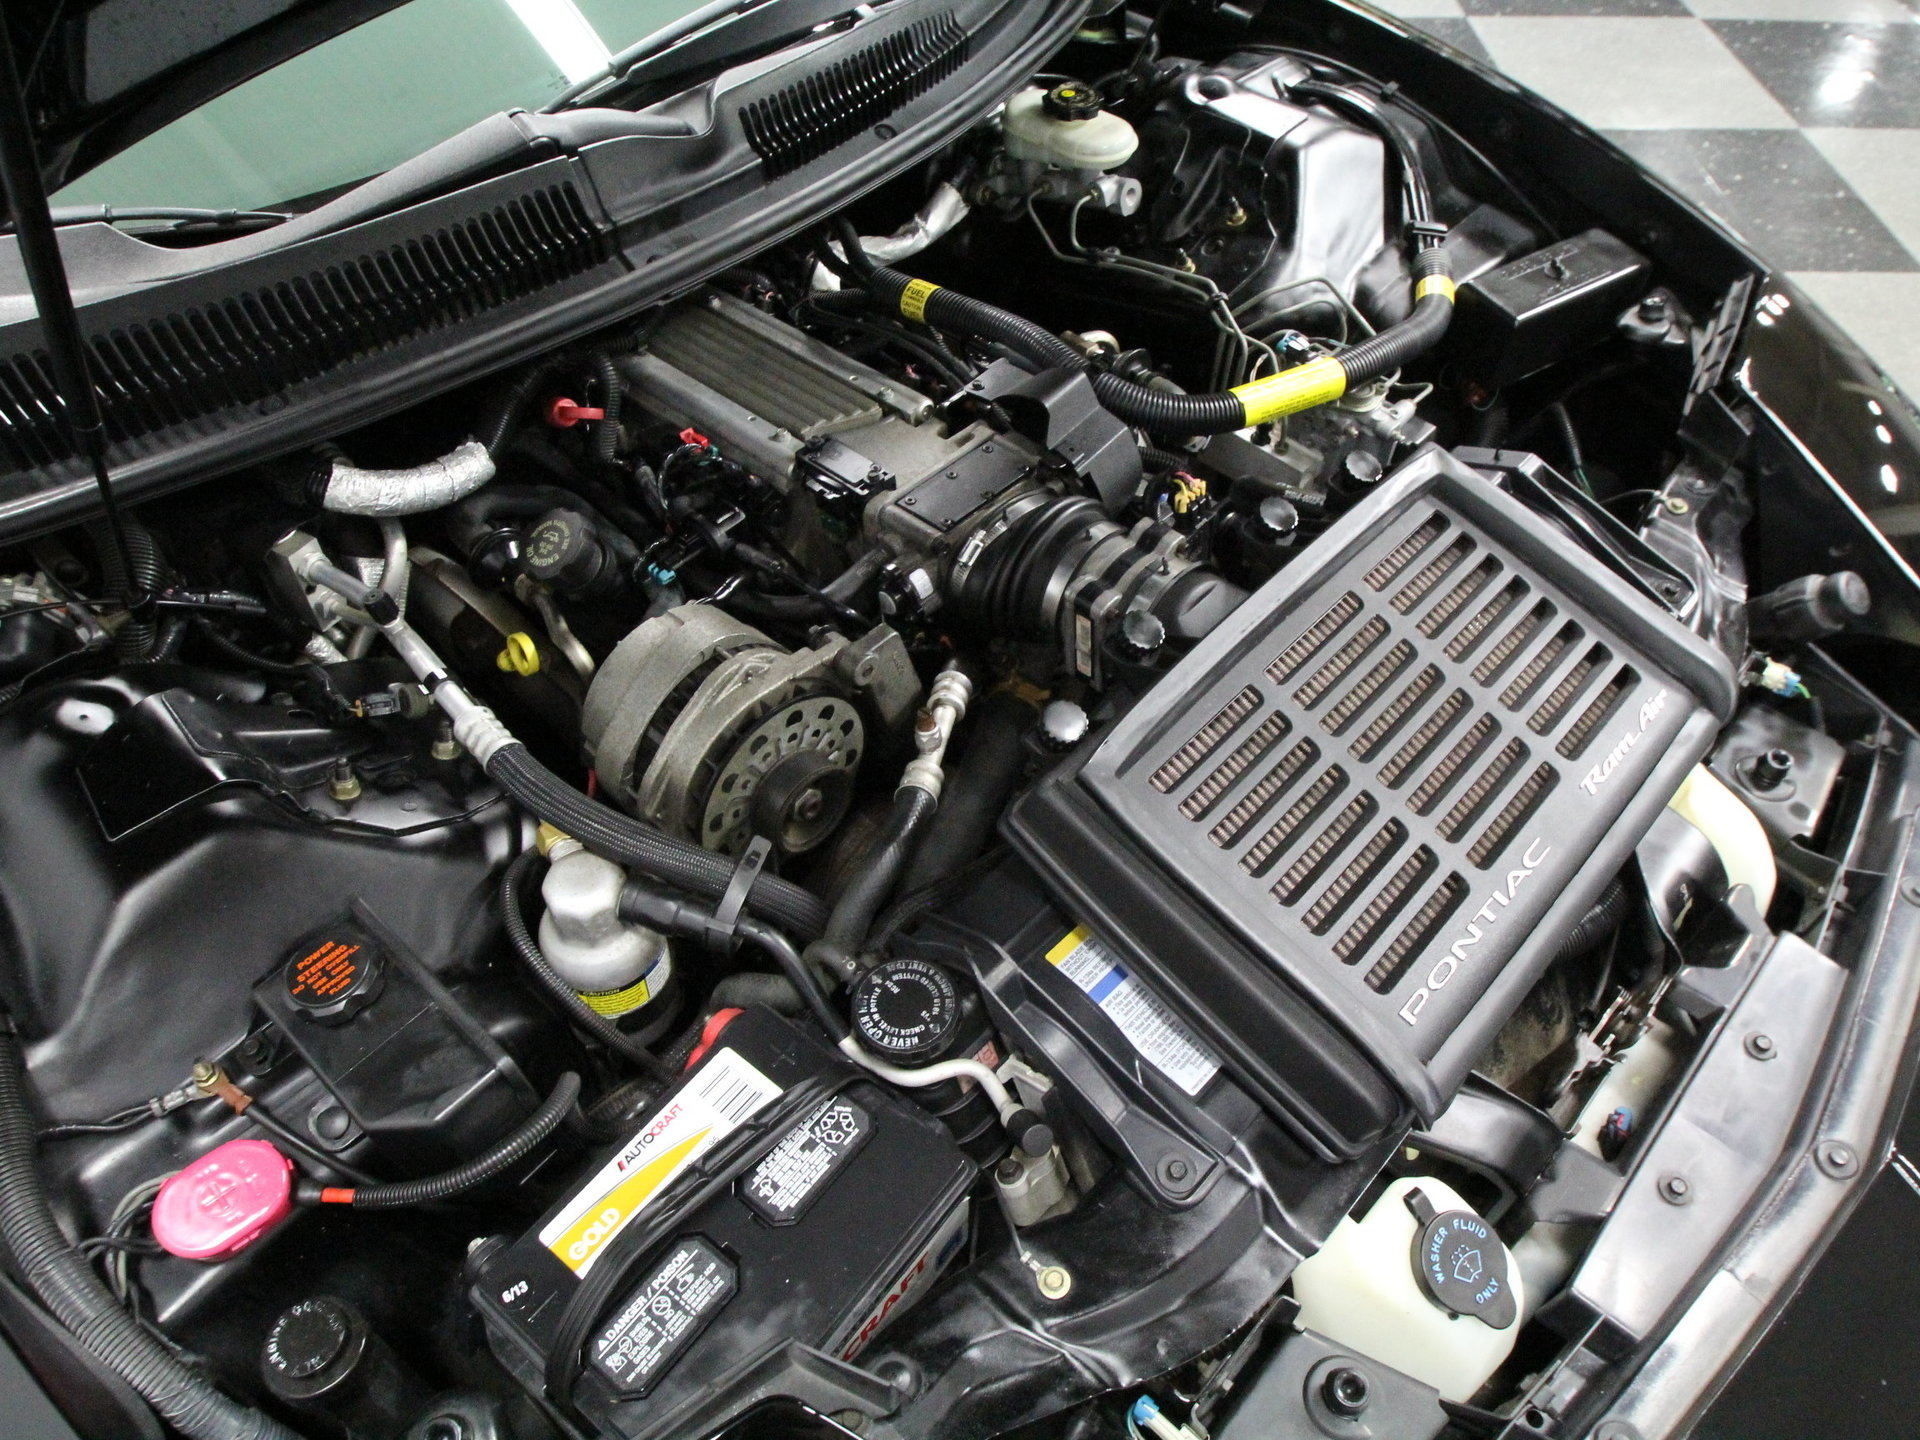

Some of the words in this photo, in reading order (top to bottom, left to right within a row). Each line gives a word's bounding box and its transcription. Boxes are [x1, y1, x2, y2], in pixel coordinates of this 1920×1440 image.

[906, 286, 925, 298] FUEL
[530, 553, 559, 566] ENGINE
[1578, 732, 1638, 798] Ram
[1635, 688, 1670, 735] Air
[1398, 836, 1552, 1025] PONTIAC
[296, 944, 348, 982] STEERING
[297, 941, 334, 969] POWER
[1061, 959, 1069, 968] FAN
[1069, 946, 1083, 960] BLADE
[1066, 953, 1084, 972] WITHOUT
[312, 976, 327, 989] USE
[330, 960, 349, 975] ONLY
[907, 963, 927, 972] VENT
[292, 984, 304, 994] DO
[306, 971, 322, 984] NOT
[316, 965, 355, 995] APPROVED
[328, 977, 351, 995] FLUID
[1083, 972, 1098, 987] UNDER
[582, 988, 619, 996] CAUTION
[1112, 990, 1121, 1000] BAG
[860, 1015, 882, 1038] OPEN
[872, 1013, 882, 1021] IN
[878, 1020, 898, 1034] LEVEL
[899, 1024, 924, 1035] CHECK
[882, 1036, 919, 1048] NEVER
[625, 1104, 683, 1165] AUTOCRAFT
[568, 1207, 621, 1261] GOLD
[1430, 1227, 1447, 1283] WASHER
[1452, 1218, 1486, 1238] FLUID
[682, 1275, 704, 1299] SULFURIC
[704, 1263, 715, 1275] ACID
[712, 1275, 720, 1283] OR
[501, 1281, 528, 1302] 6/13
[605, 1294, 647, 1340] DANGER
[652, 1249, 689, 1290] POISON
[1475, 1277, 1498, 1303] ONLY
[664, 1309, 674, 1320] NO
[841, 1251, 931, 1362] CRAFT
[629, 1318, 647, 1337] SHIELD
[634, 1327, 648, 1341] EYES
[633, 1345, 650, 1363] GASES
